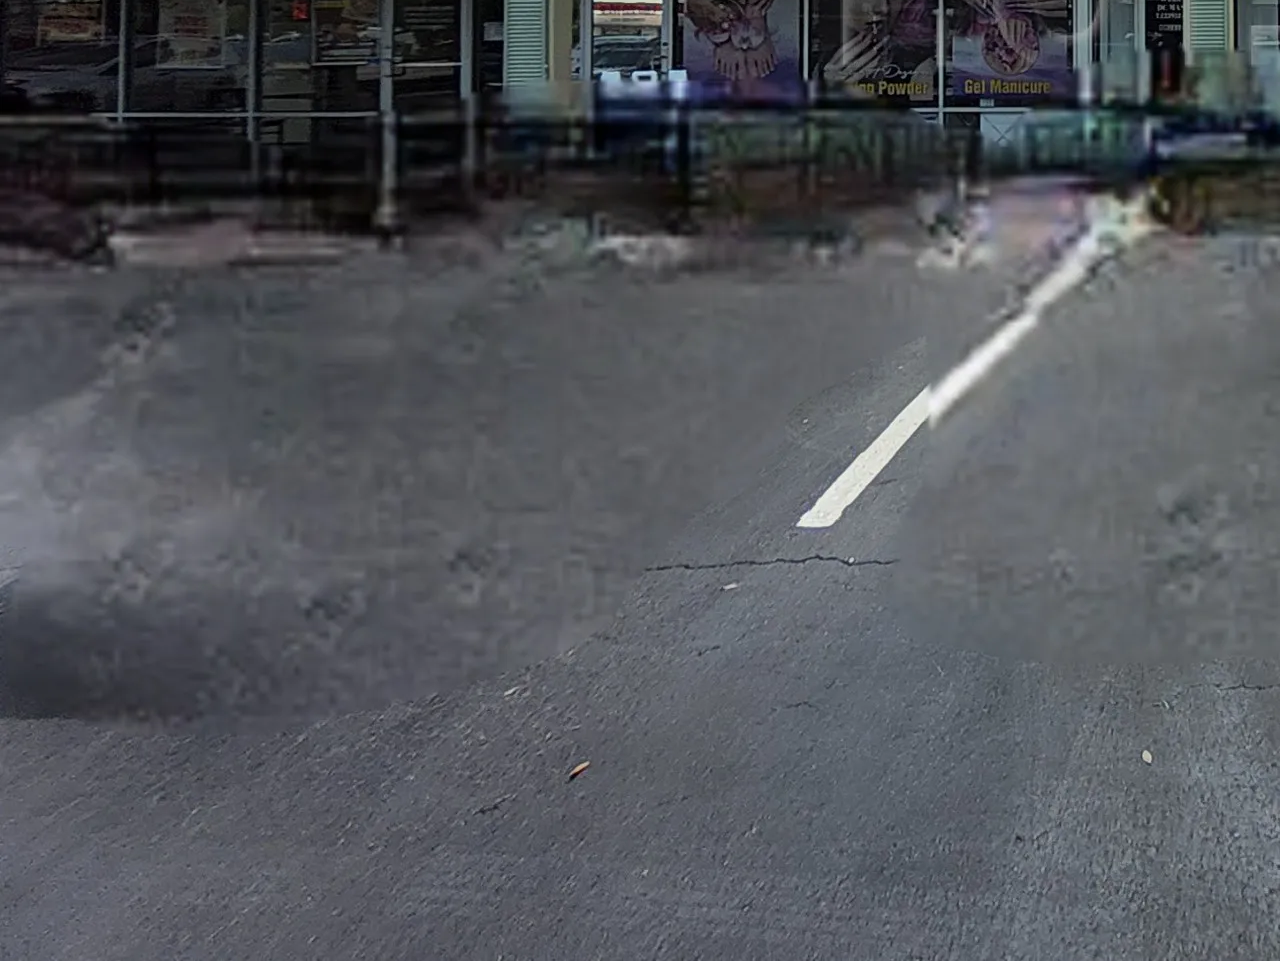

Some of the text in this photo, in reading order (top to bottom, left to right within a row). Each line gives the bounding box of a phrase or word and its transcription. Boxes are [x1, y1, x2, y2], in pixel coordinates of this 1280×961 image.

[877, 80, 929, 96] Powder
[964, 79, 1051, 95] Gel Manicure
